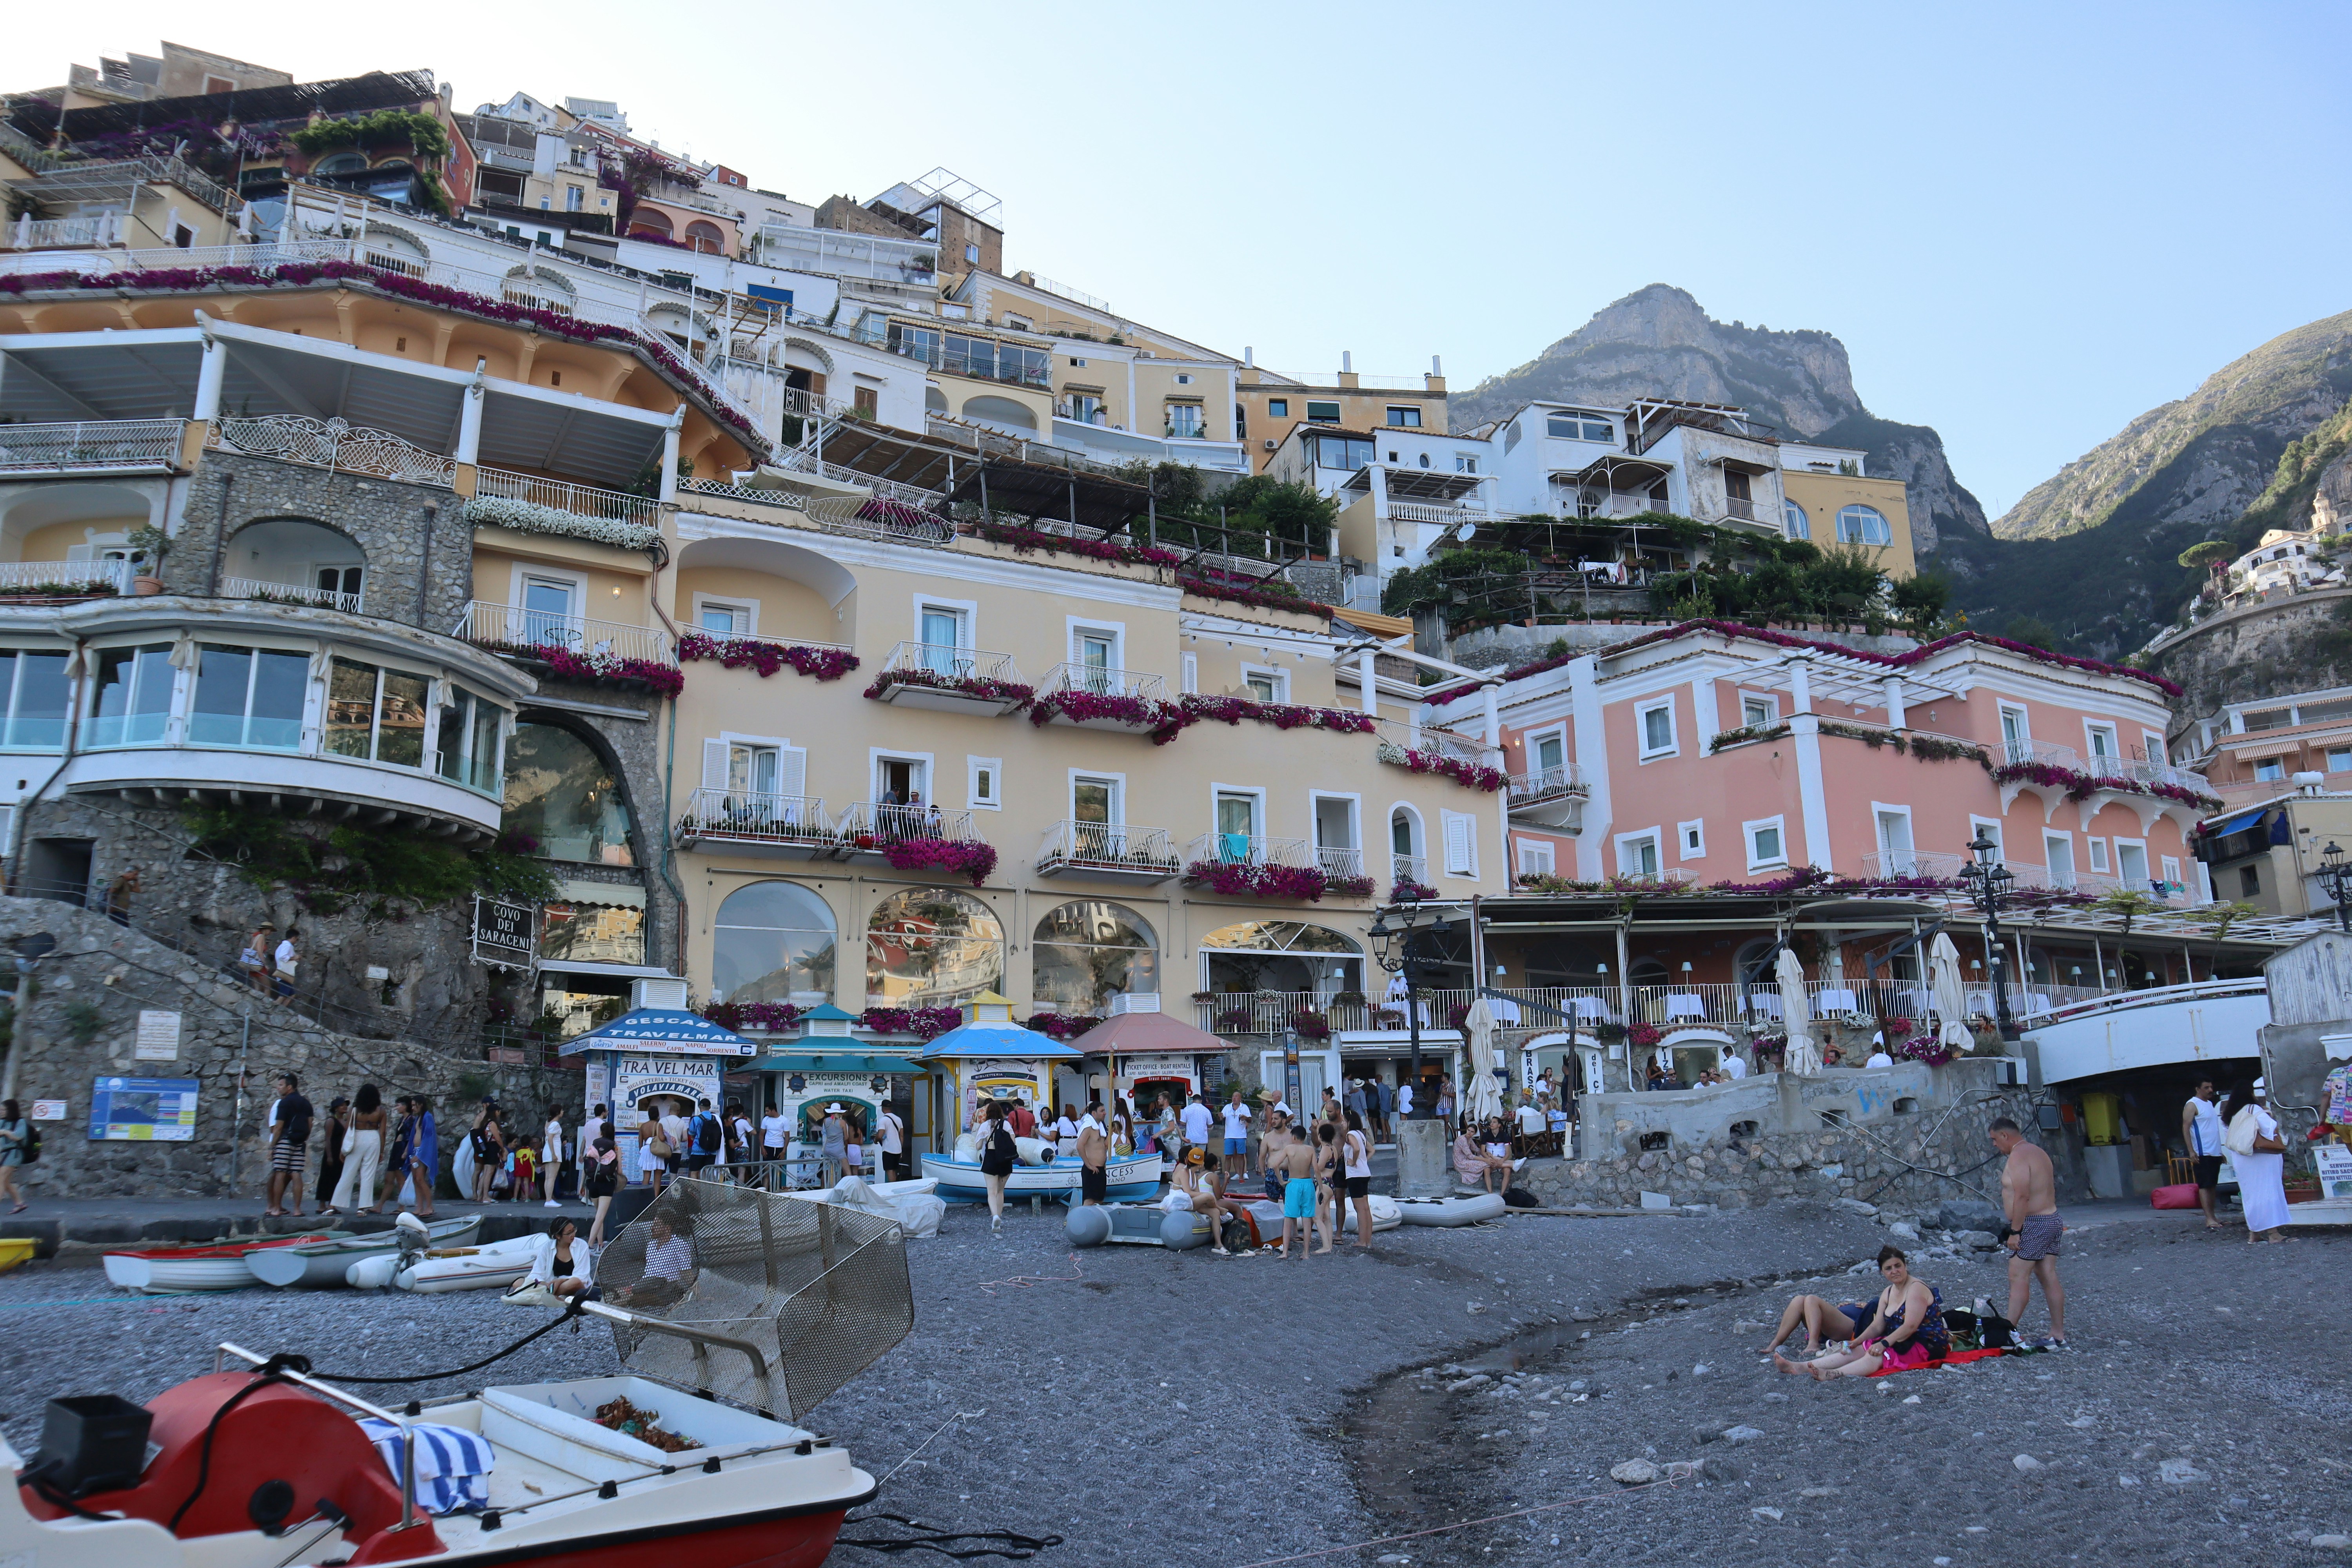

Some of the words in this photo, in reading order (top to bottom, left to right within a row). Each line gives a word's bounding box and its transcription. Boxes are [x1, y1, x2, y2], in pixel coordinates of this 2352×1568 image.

[494, 905, 520, 921] COVO
[497, 918, 514, 933] DEI
[479, 928, 529, 949] SARACENI
[625, 1018, 711, 1028] GESCAB
[609, 1029, 737, 1041] TRAVELMAR
[683, 1063, 713, 1076] MAR
[627, 1077, 664, 1091] BIGLIETTERIA
[1106, 1166, 1134, 1178] NCESS
